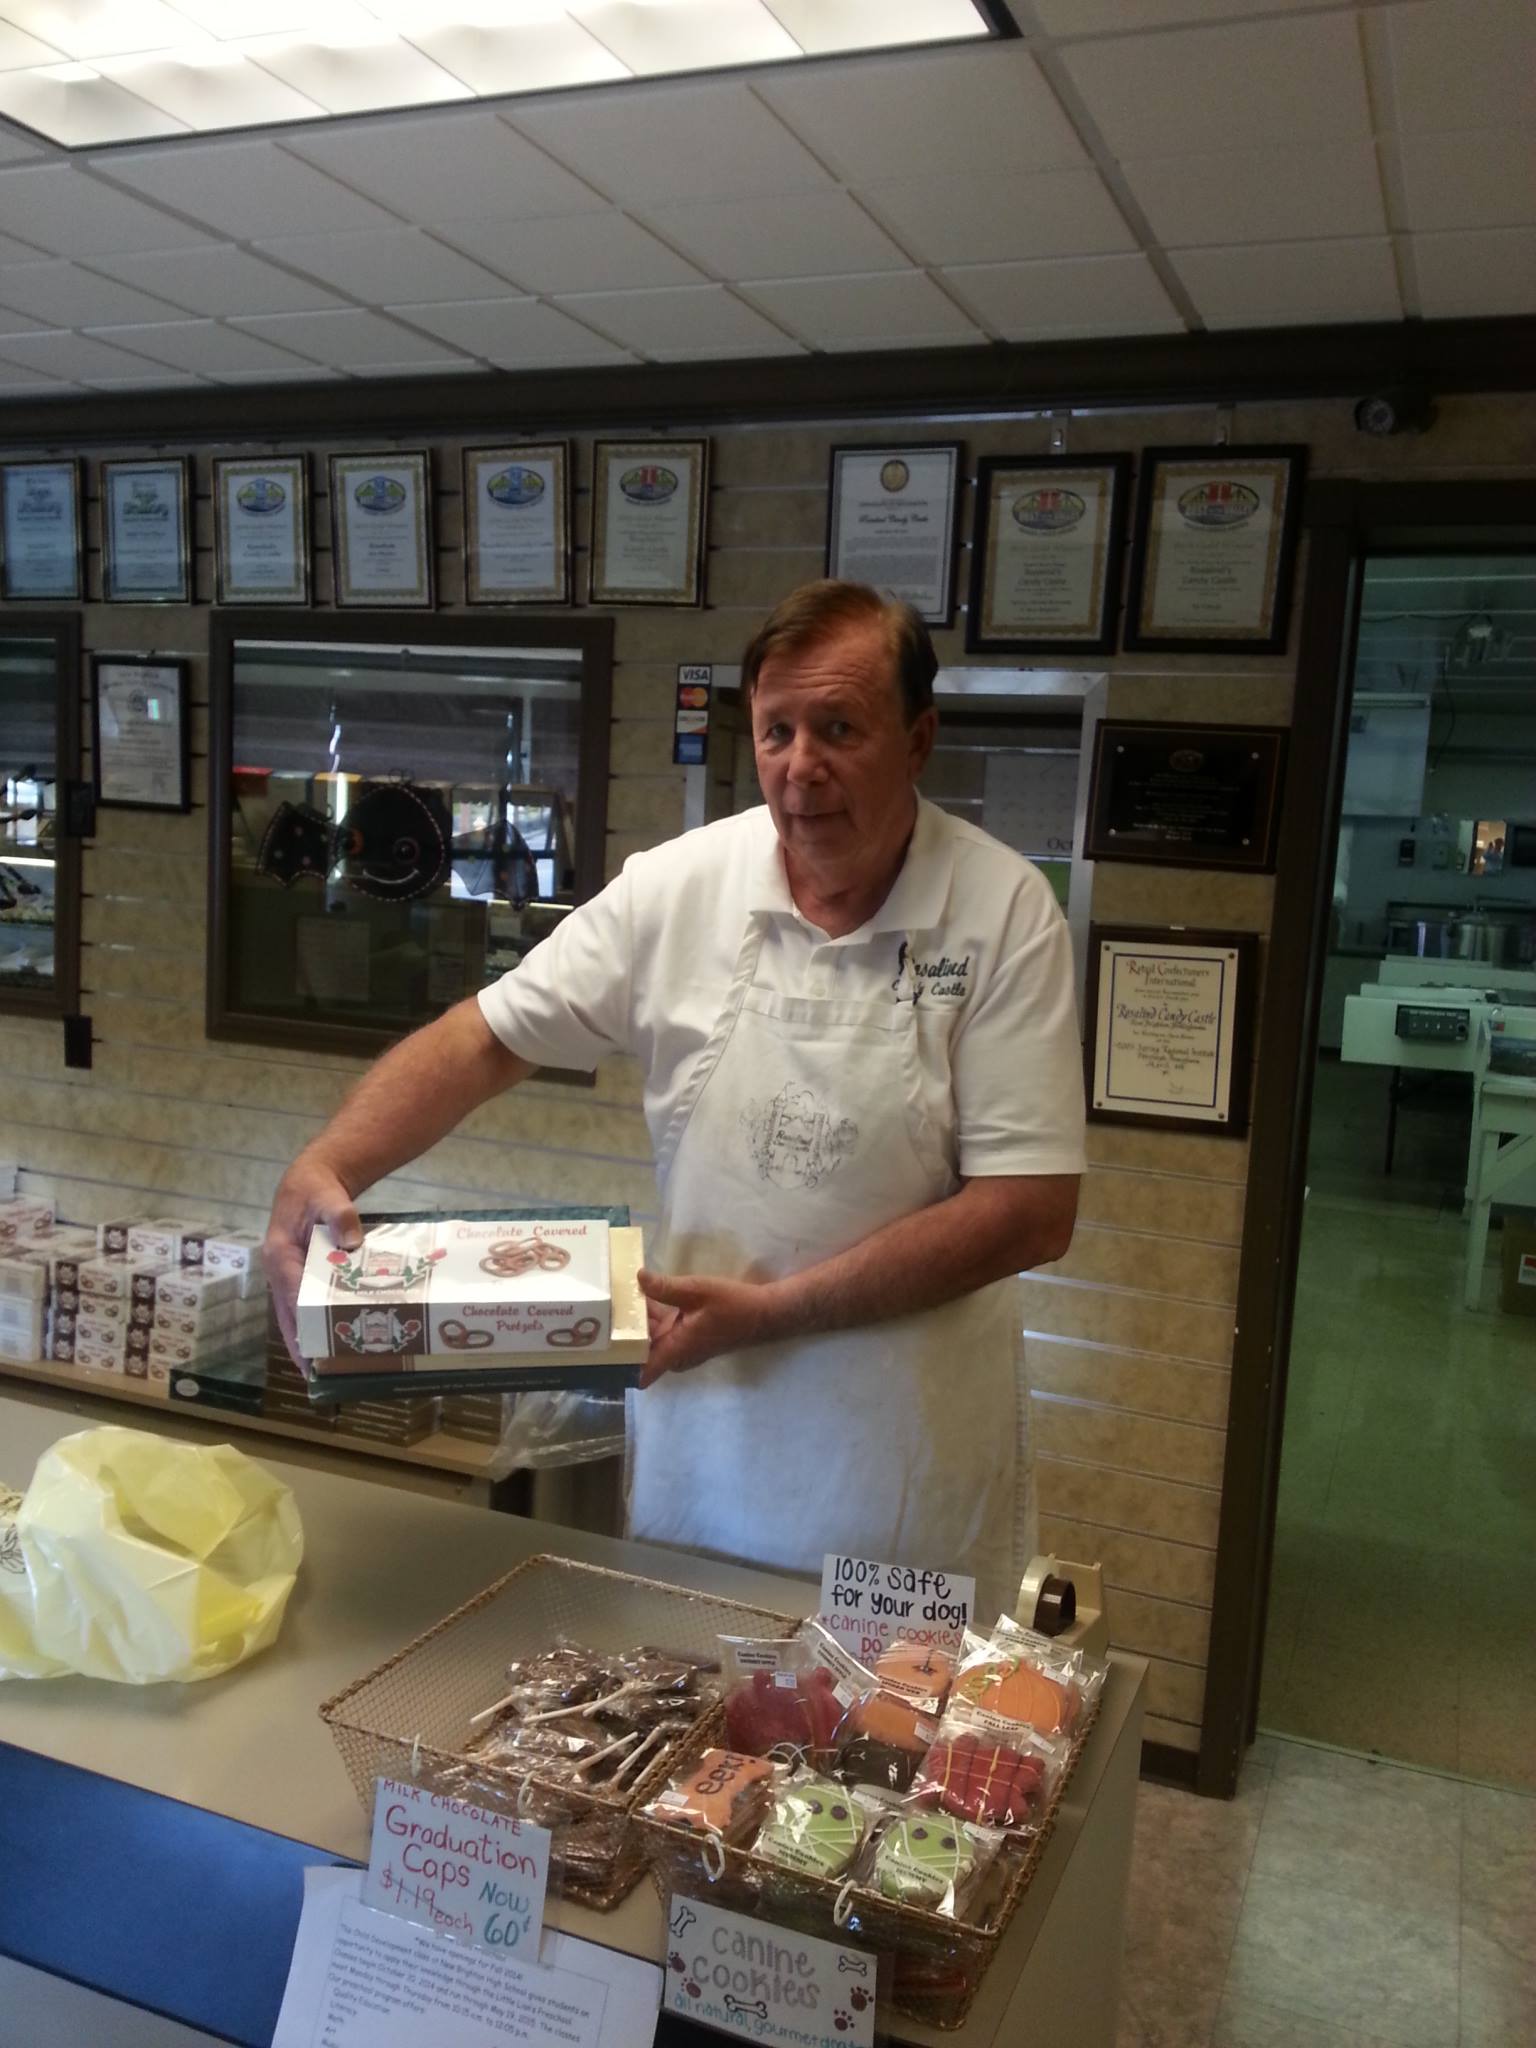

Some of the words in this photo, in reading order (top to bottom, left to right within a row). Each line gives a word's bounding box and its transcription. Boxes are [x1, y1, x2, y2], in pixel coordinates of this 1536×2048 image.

[683, 669, 708, 681] VISA
[456, 1226, 523, 1239] Chocolate
[533, 1225, 588, 1237] Covered
[462, 1304, 520, 1317] Chocolate
[527, 1304, 574, 1317] Covered
[496, 1319, 545, 1333] Pretzels
[834, 1557, 880, 1587] 100%
[831, 1584, 863, 1608] for
[871, 1592, 915, 1618] your
[922, 1601, 968, 1630] dog!
[861, 1637, 883, 1653] DO
[896, 1626, 962, 1649] cookies
[383, 1779, 421, 1803] MILK
[431, 1795, 521, 1837] CHOCOLATE
[385, 1804, 537, 1880] Graduation
[403, 1843, 471, 1891] Caps
[441, 1959, 455, 1970] New
[456, 1965, 484, 1980] Brighton
[505, 1982, 527, 1996] School
[547, 1999, 579, 2014] students
[490, 2004, 504, 2018] May
